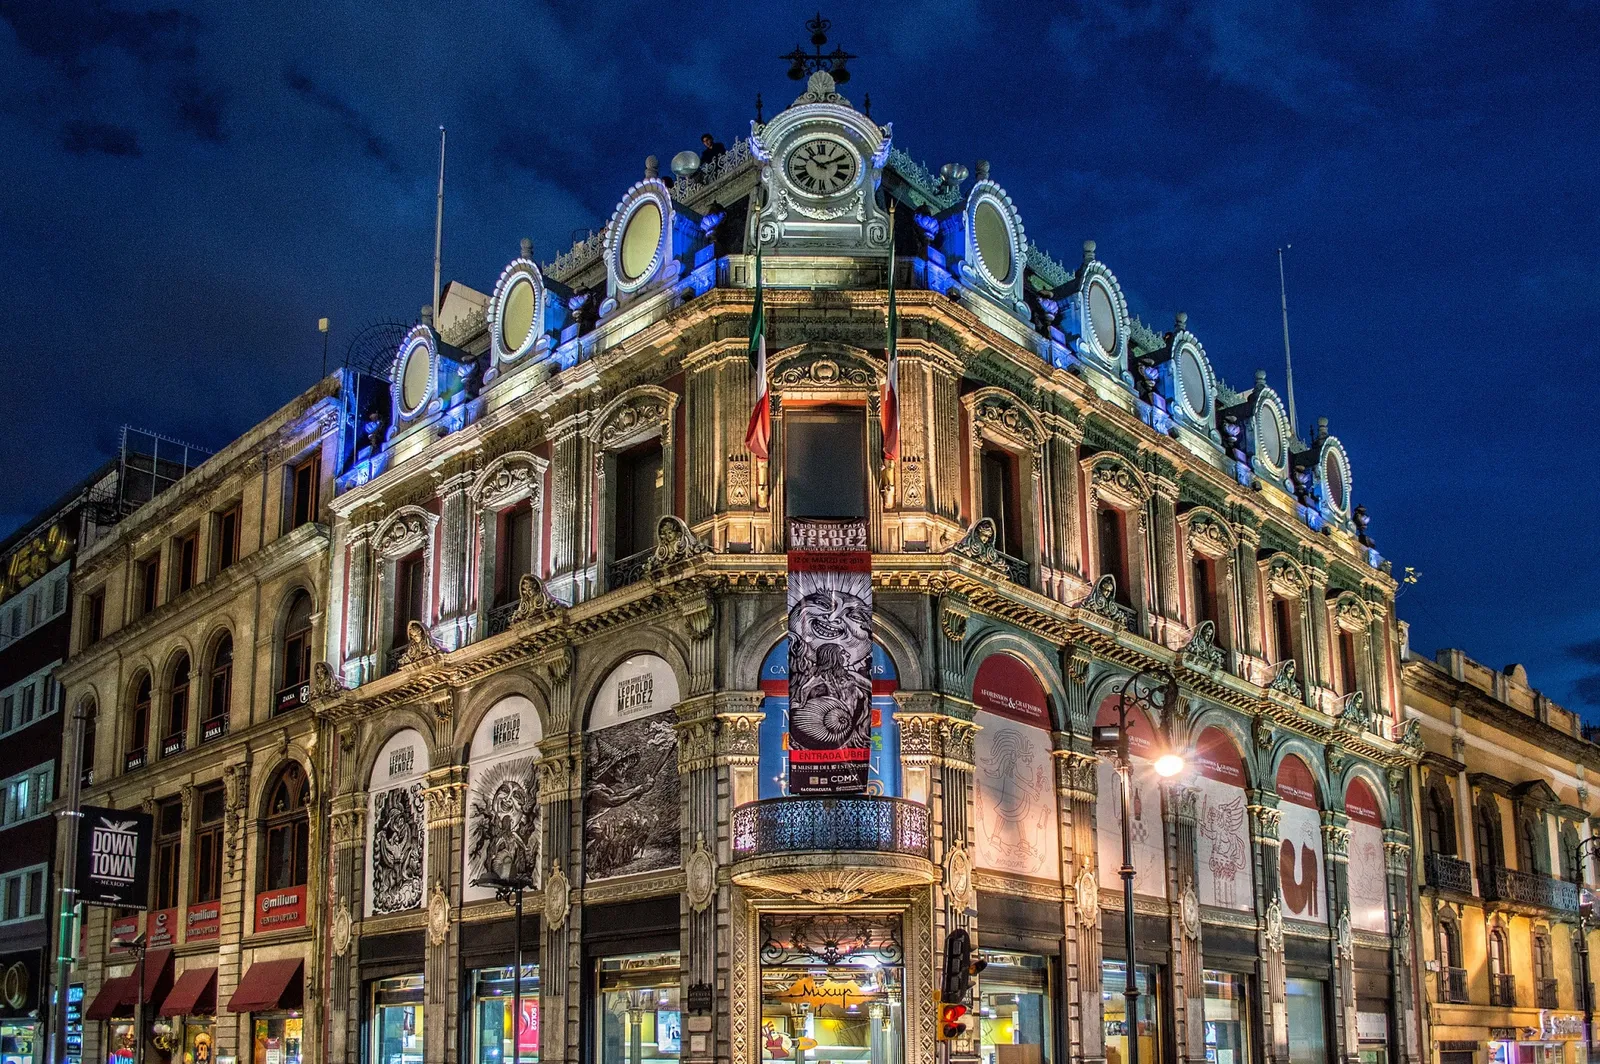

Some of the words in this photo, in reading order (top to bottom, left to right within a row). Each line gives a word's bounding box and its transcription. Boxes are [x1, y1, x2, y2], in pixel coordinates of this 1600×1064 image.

[791, 527, 866, 538] LEOPOLDO
[791, 537, 867, 547] MENDEZ
[618, 679, 653, 699] LEOPOLDO
[618, 690, 653, 712] MENDEZ
[1008, 697, 1016, 709] &
[494, 718, 520, 734] LEOPOLDO
[493, 728, 519, 746] MENDEZ
[390, 750, 414, 765] LEOPOLDO
[799, 751, 842, 760] ENTRADA
[389, 760, 413, 776] MENDEZ
[831, 773, 858, 783] CDMX
[93, 831, 138, 856] DOWN
[92, 852, 136, 878] TOWN
[801, 984, 854, 1009] Mixup
